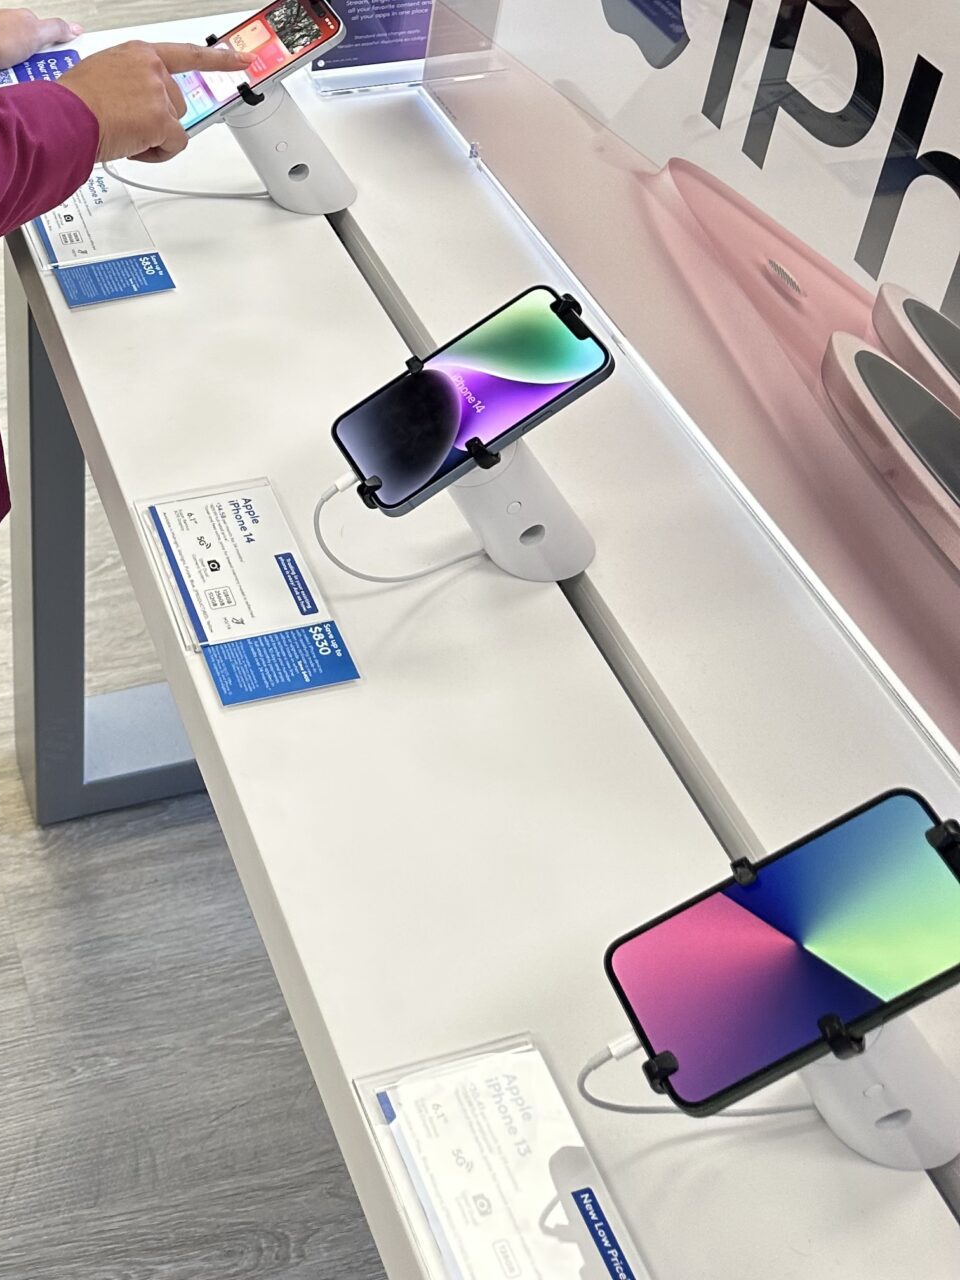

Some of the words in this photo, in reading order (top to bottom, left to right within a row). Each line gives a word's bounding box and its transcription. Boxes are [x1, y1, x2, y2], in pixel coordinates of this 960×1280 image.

[36, 59, 47, 73] Your
[47, 58, 58, 70] Our
[88, 178, 98, 197] Phone
[94, 197, 104, 205] 15
[95, 176, 108, 193] Apple
[139, 256, 155, 275] $830
[150, 254, 158, 265] Save
[452, 374, 476, 404] iPhone
[472, 400, 485, 413] 14
[241, 498, 260, 524] Apple
[228, 500, 247, 531] iPhone
[243, 532, 256, 543] 14
[196, 535, 208, 546] 5G
[208, 591, 218, 607] 512GB
[214, 590, 225, 606] 256GB
[222, 589, 232, 604] 128GB
[308, 626, 331, 655] $830
[323, 623, 334, 639] Save
[330, 639, 339, 649] up
[335, 648, 342, 657] to
[502, 1074, 532, 1122] Apple
[485, 1077, 518, 1135] iPhone
[514, 1138, 532, 1157] 13
[451, 1148, 470, 1167] 5G
[581, 1193, 598, 1220] New
[594, 1221, 611, 1247] Low
[607, 1249, 632, 1280] Price
